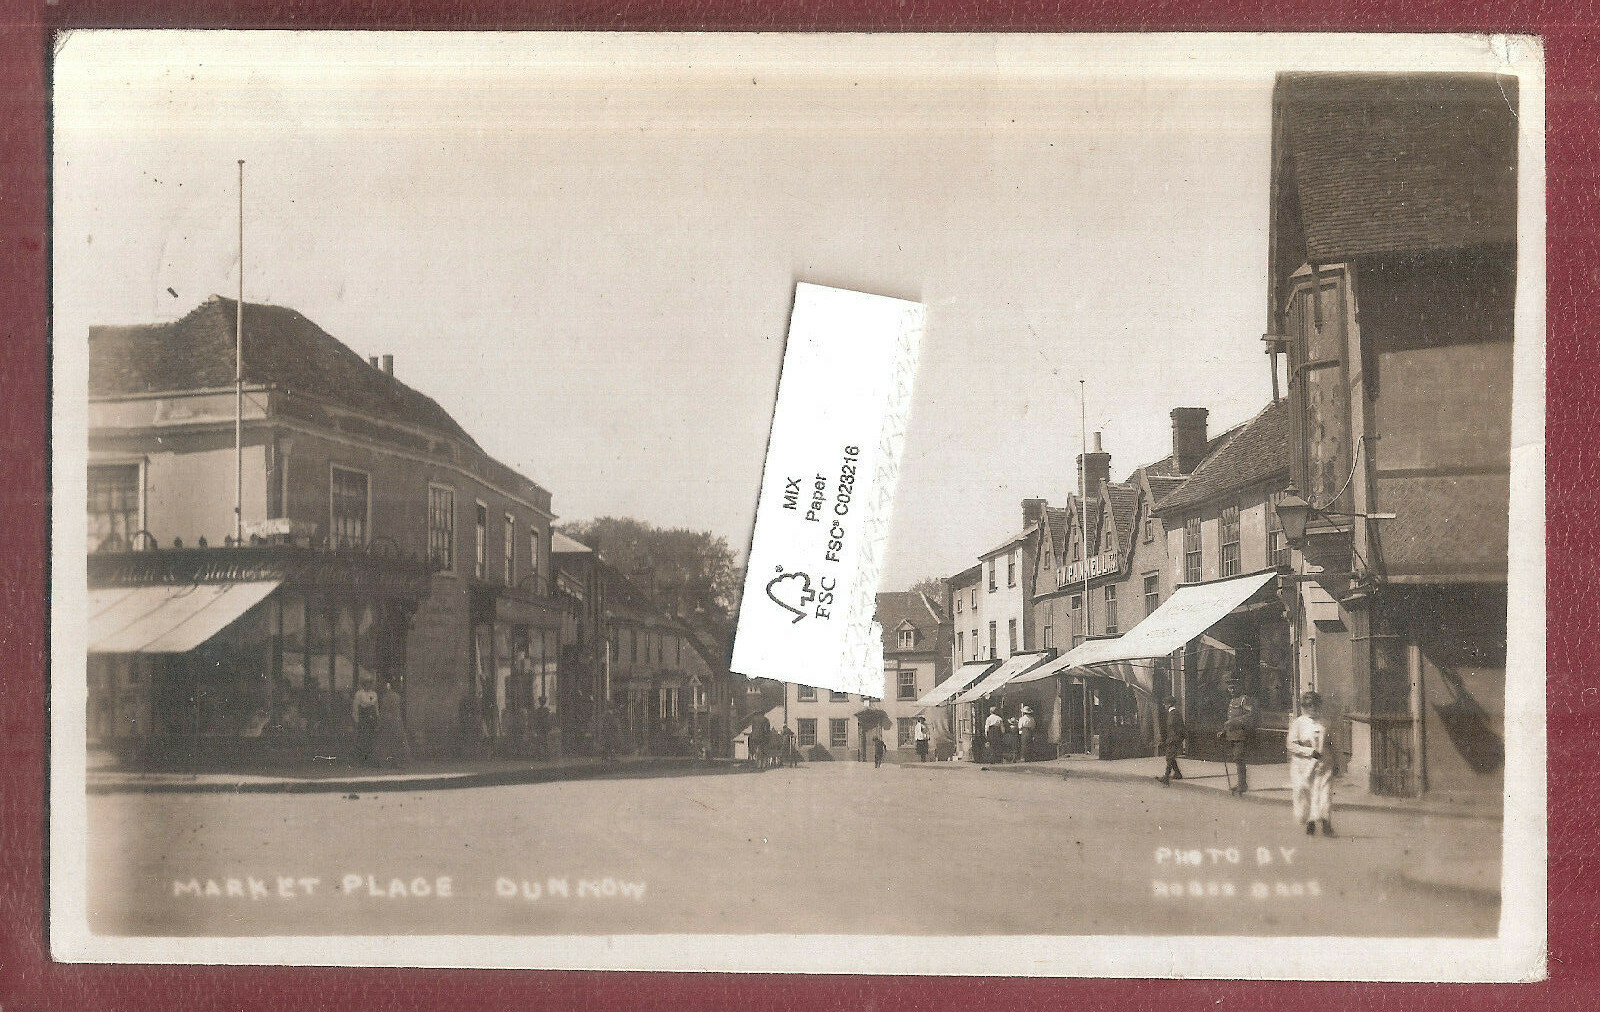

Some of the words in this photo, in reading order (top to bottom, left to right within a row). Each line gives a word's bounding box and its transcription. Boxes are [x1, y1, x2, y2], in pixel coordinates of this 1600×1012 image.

[783, 477, 801, 510] MIX
[806, 474, 827, 522] Paper
[835, 445, 860, 516] C023216
[816, 576, 836, 620] FSC
